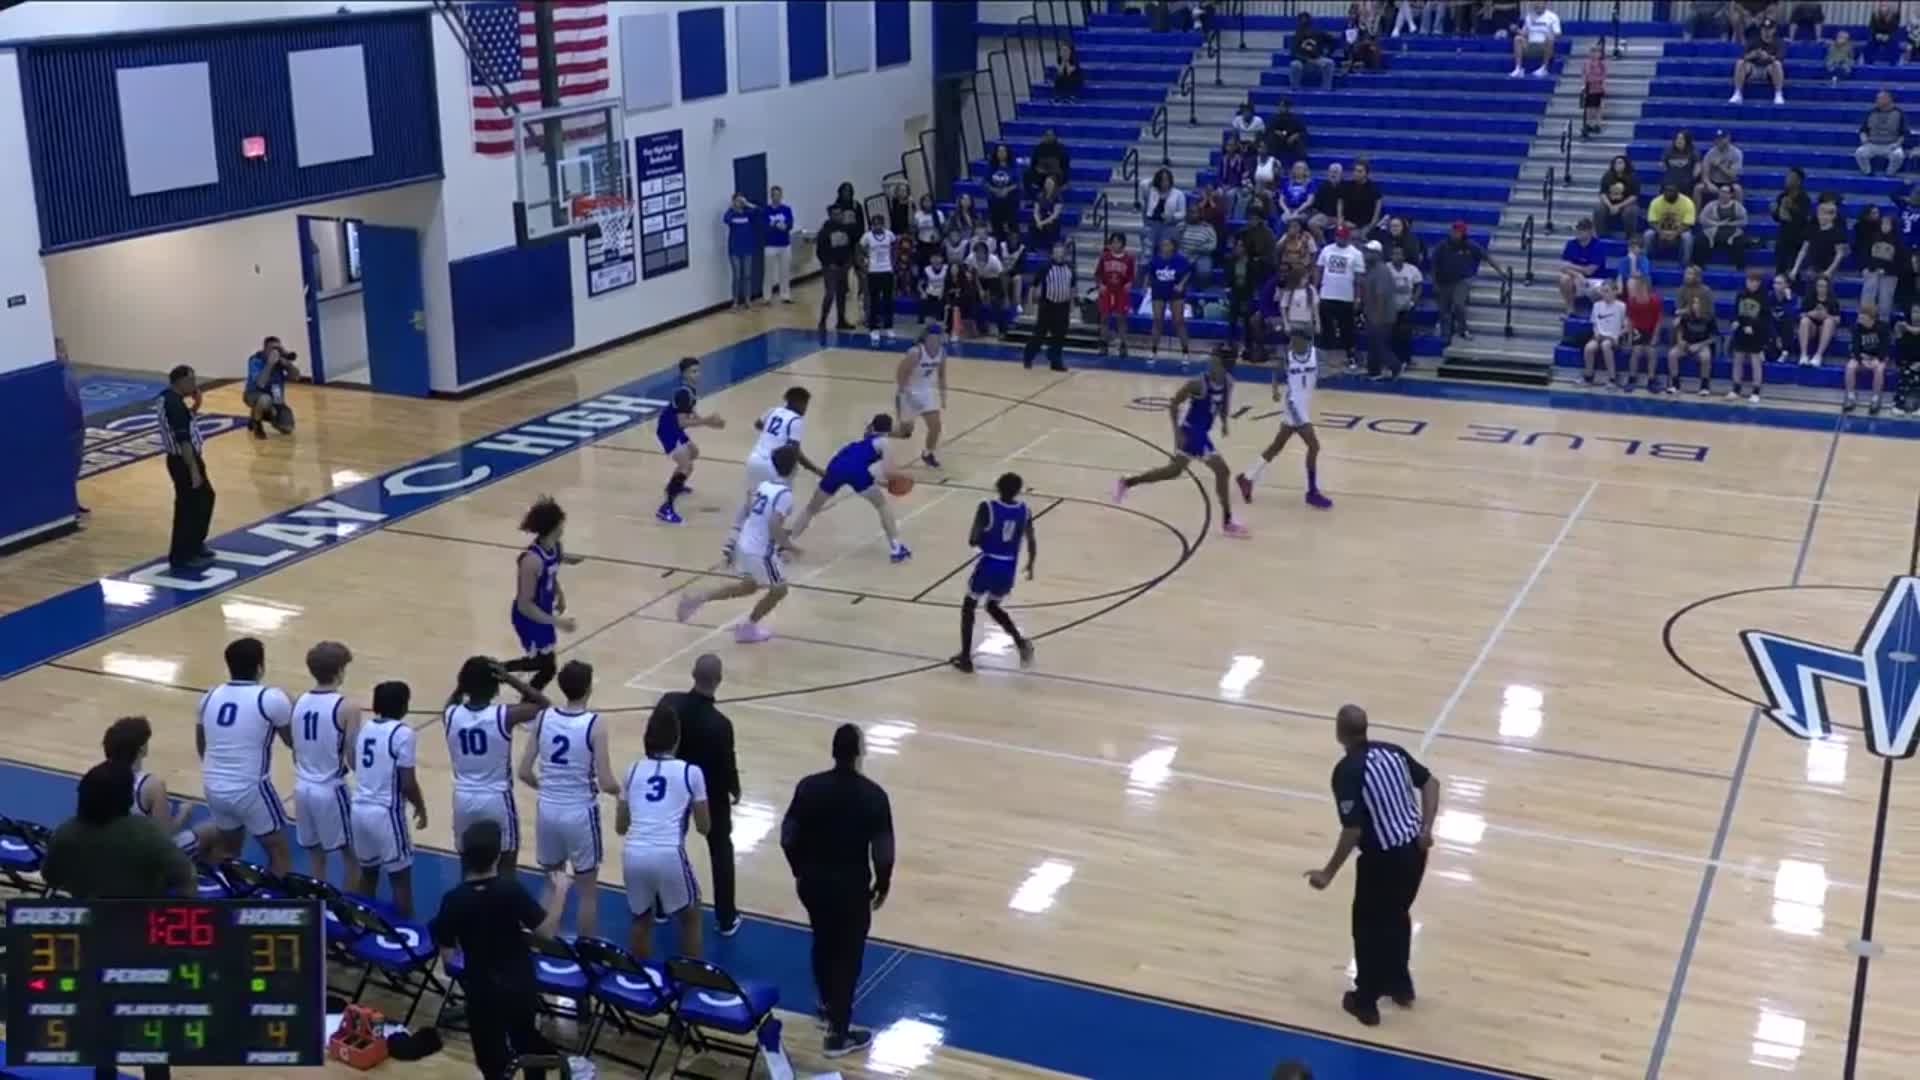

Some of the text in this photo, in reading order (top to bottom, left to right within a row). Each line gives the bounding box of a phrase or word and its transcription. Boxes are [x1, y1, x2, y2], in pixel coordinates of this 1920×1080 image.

[767, 415, 784, 436] 12
[1457, 424, 1710, 462] BLUE
[129, 500, 388, 590] CLAY
[474, 395, 670, 455] HIGH
[216, 702, 238, 726] 0
[303, 711, 319, 741] 11
[362, 738, 376, 768] 5
[458, 728, 488, 755] 10
[551, 735, 570, 765] 2
[645, 776, 667, 801] 3
